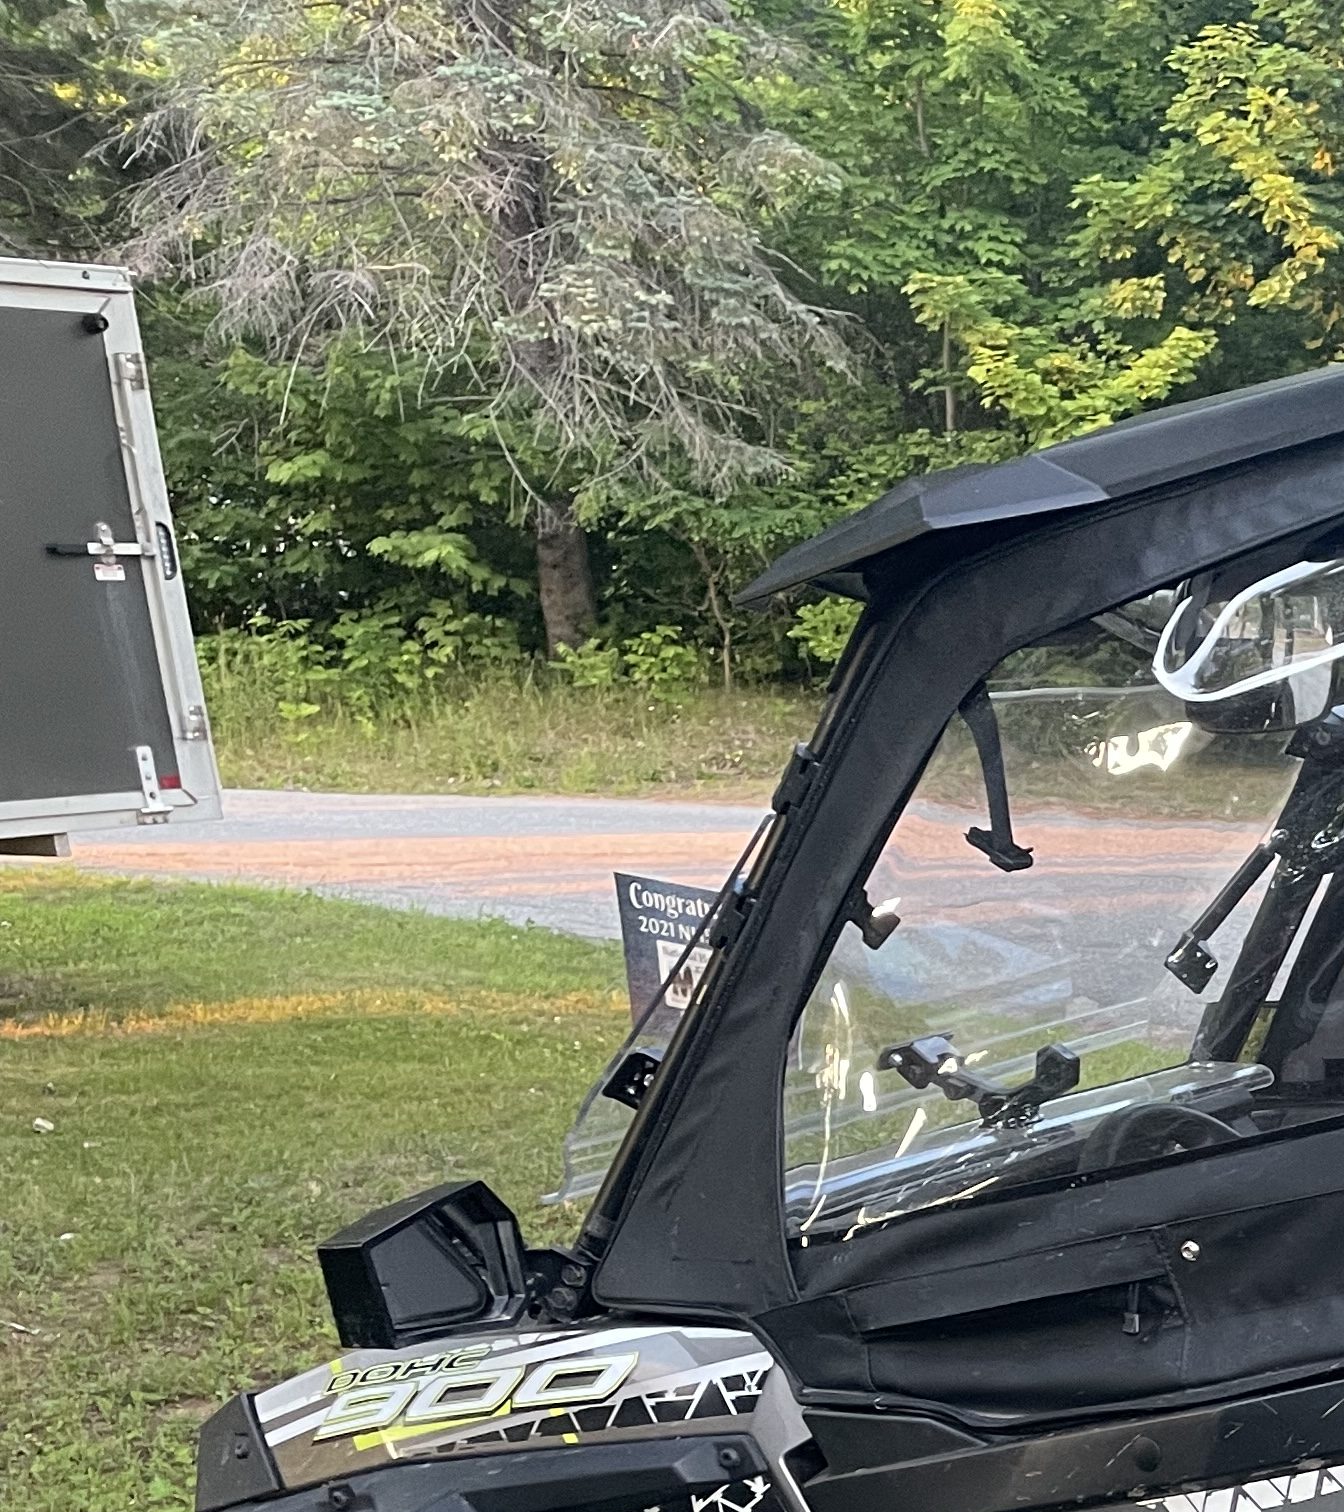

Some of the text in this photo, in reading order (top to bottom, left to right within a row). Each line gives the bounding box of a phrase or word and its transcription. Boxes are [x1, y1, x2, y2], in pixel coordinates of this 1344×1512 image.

[638, 916, 675, 938] 2021
[322, 1344, 492, 1395] DOHC
[313, 1352, 639, 1443] 900
